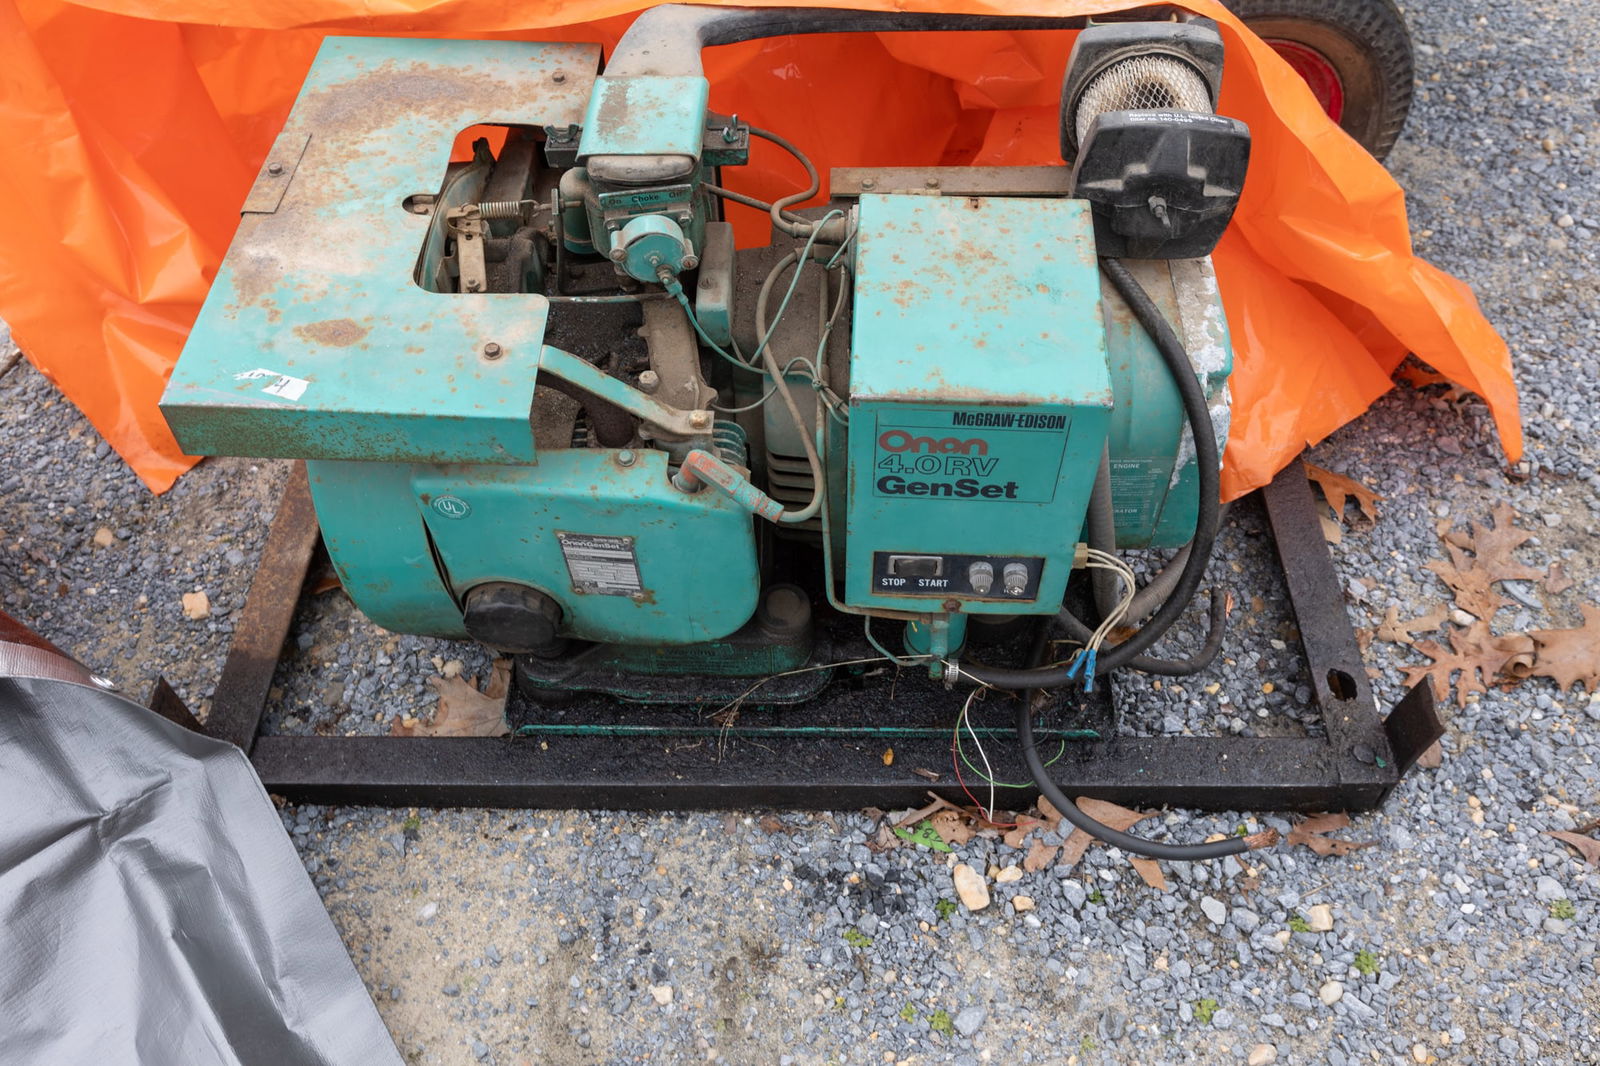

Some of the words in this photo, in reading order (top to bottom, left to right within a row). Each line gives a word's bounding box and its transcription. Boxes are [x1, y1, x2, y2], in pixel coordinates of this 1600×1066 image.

[631, 193, 660, 203] Choke
[952, 412, 1067, 430] McGRAW-EDISON
[878, 429, 989, 456] Onan
[876, 475, 1020, 499] GenSet
[882, 578, 906, 587] STOP
[918, 579, 949, 588] START
